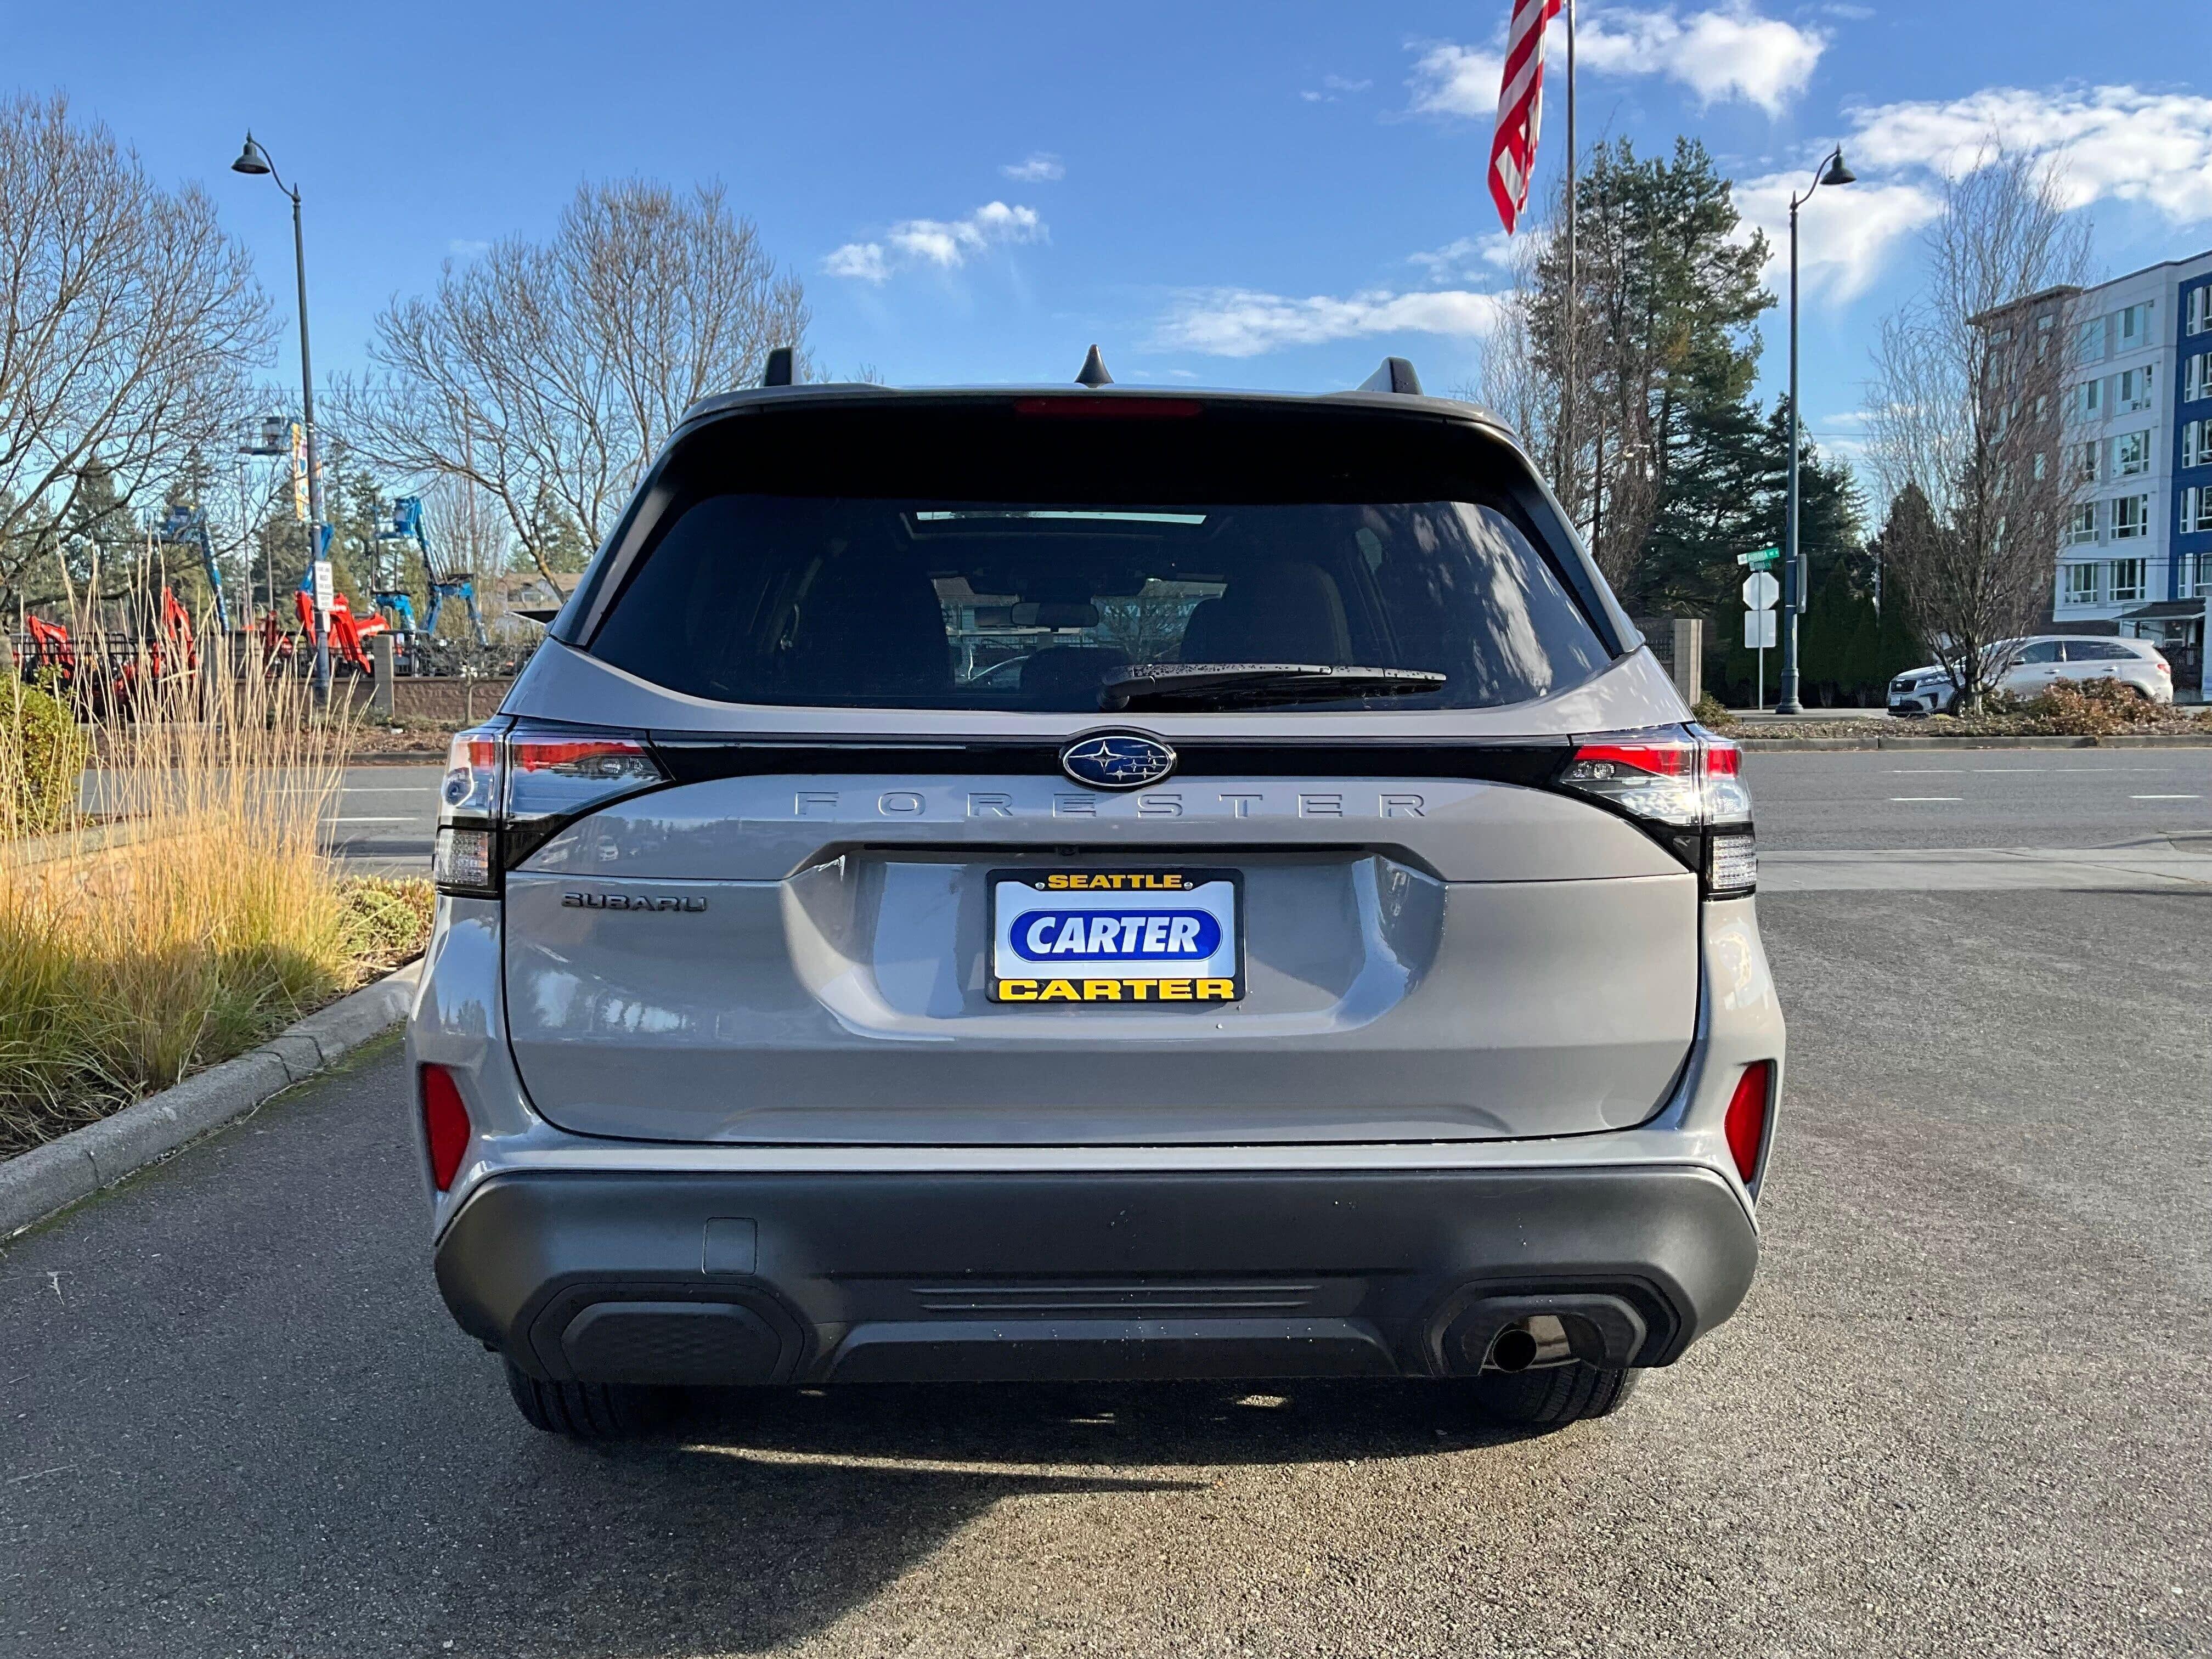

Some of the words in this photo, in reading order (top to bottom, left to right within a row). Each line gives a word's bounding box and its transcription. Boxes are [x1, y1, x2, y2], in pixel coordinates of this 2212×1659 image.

[795, 791, 1425, 817] FORESTER
[1048, 874, 1182, 889] SEATTLE
[561, 892, 707, 911] SUBARU
[1026, 916, 1200, 954] CARTER
[998, 979, 1234, 1000] CARTER
